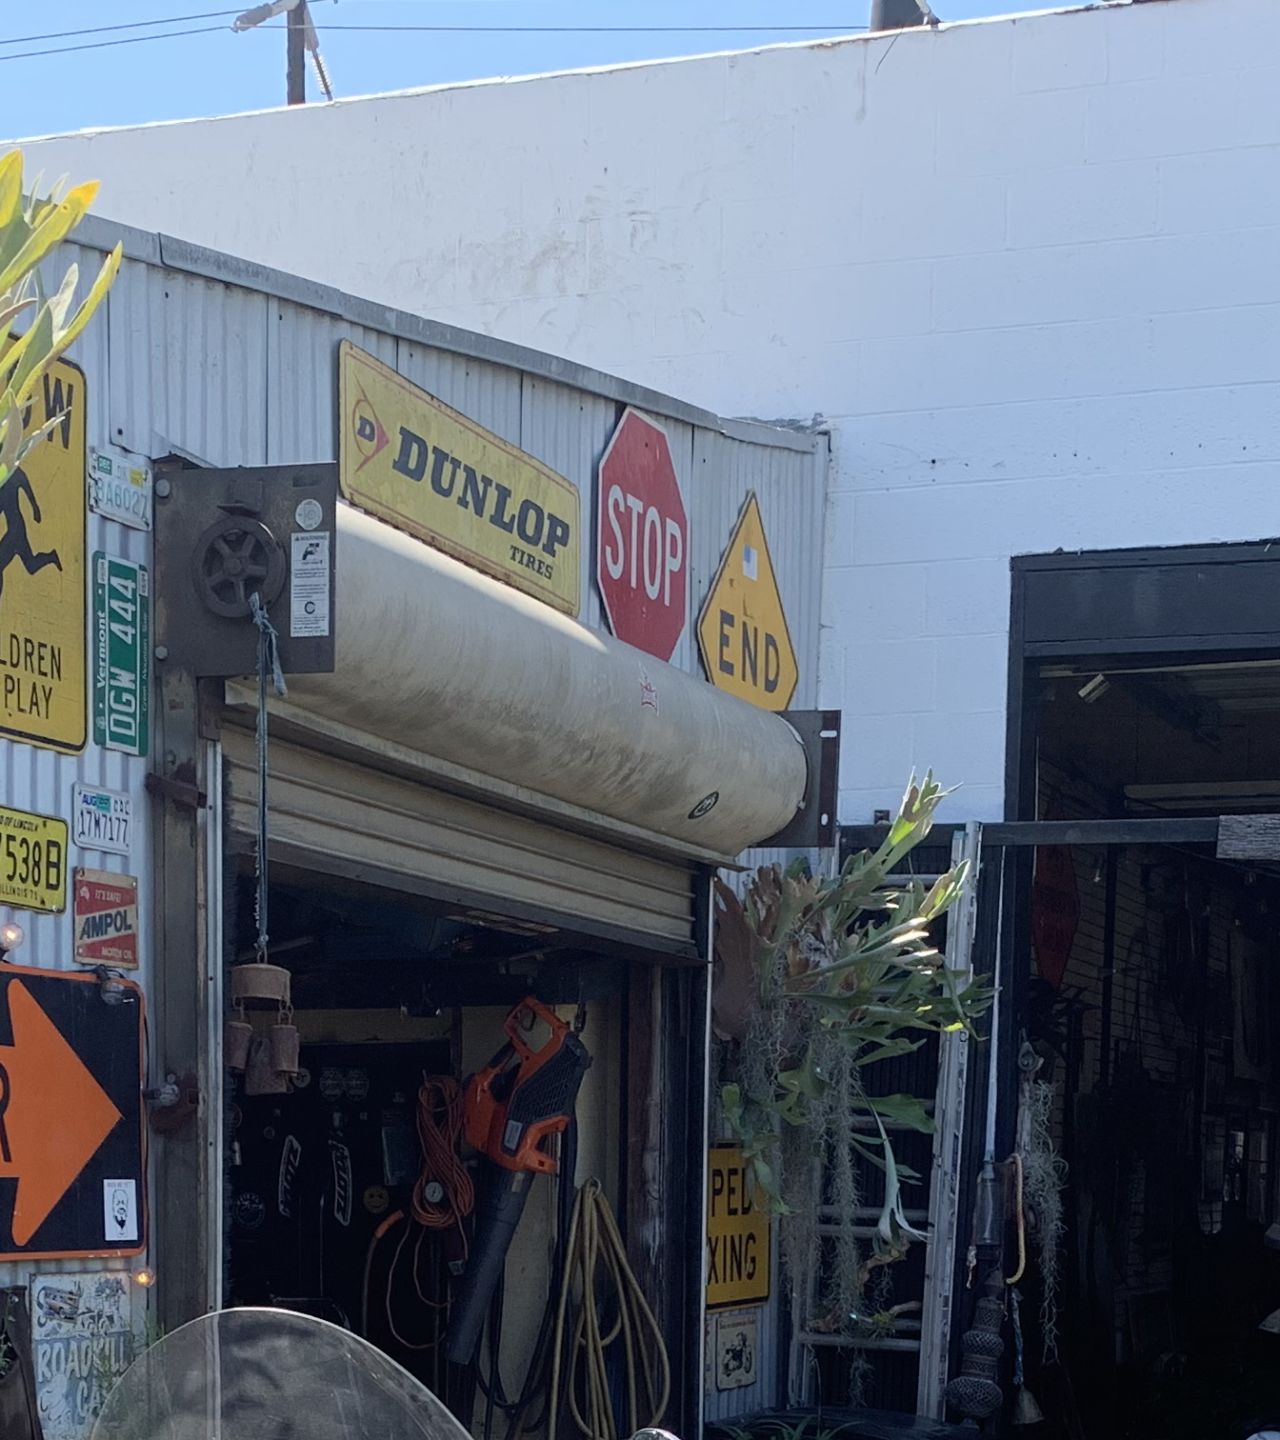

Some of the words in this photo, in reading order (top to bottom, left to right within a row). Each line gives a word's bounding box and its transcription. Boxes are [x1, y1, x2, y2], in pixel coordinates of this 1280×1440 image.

[391, 426, 570, 559] DUNLOP
[509, 544, 554, 581] TIRES
[604, 483, 683, 607] STOP
[109, 575, 136, 646] 444
[96, 610, 107, 689] Vermont
[718, 608, 781, 695] END
[3, 672, 53, 720] PLAY
[109, 666, 136, 737] DGW
[4, 816, 13, 827] OF
[13, 817, 39, 833] LINCOLN
[82, 793, 97, 806] AUG
[0, 882, 29, 897] ILLINOIS
[80, 909, 133, 941] AMPOL
[707, 1232, 757, 1285] XING
